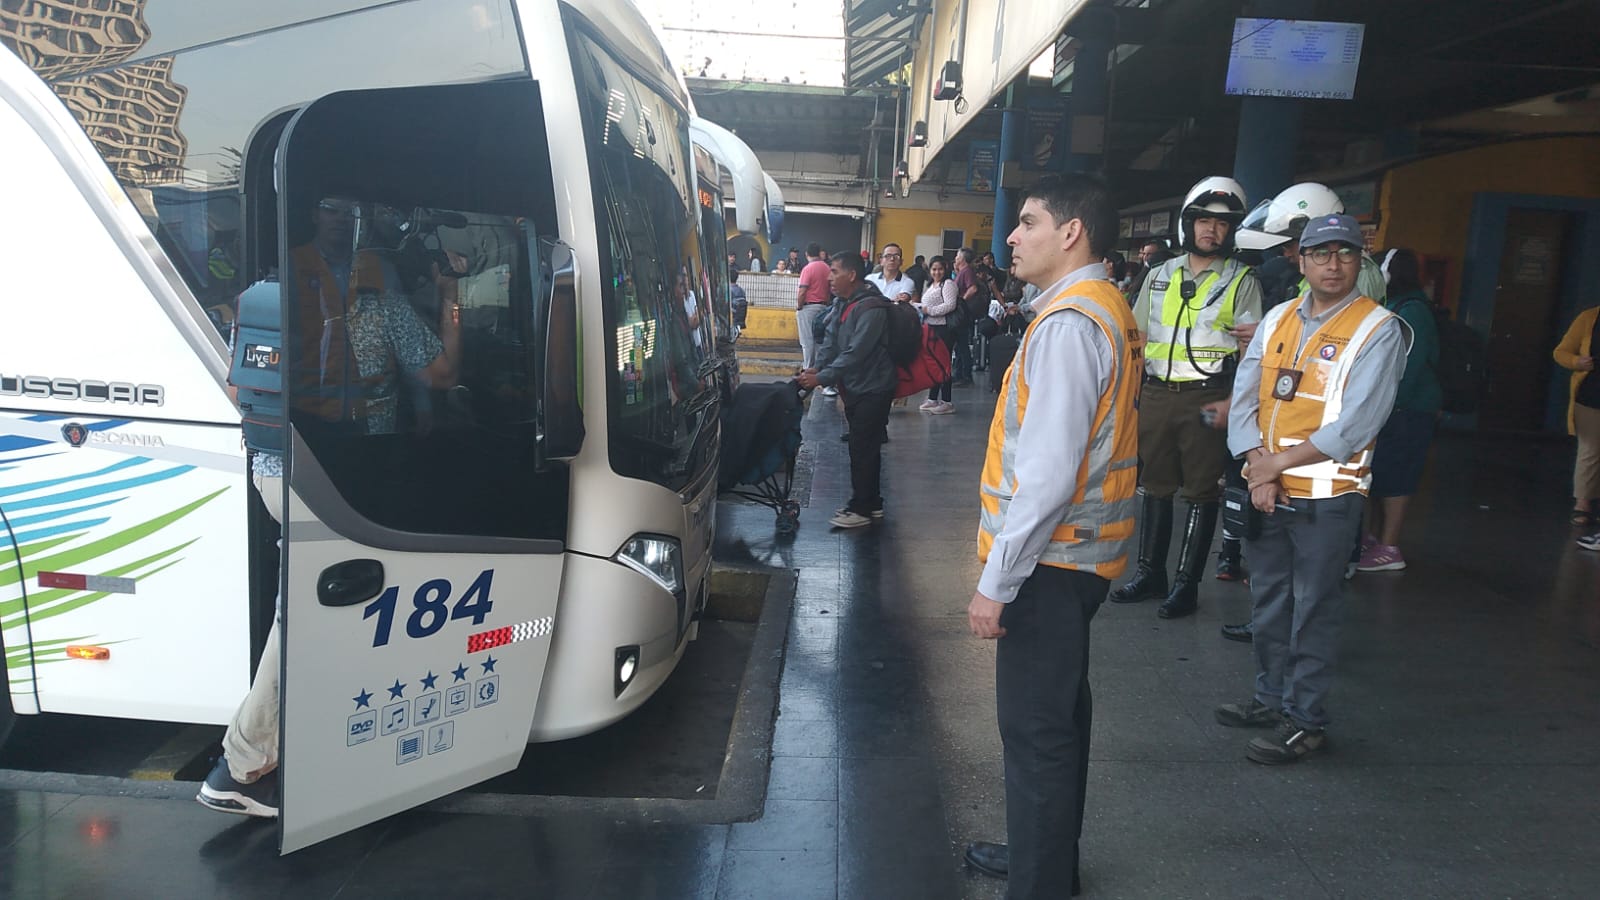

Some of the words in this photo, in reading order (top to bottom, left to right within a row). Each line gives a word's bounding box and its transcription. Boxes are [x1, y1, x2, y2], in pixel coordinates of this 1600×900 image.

[1242, 87, 1258, 96] LEY
[1277, 89, 1309, 98] TABACO
[91, 430, 165, 447] SCANIA
[362, 568, 495, 648] 184
[351, 719, 374, 732] DVD
